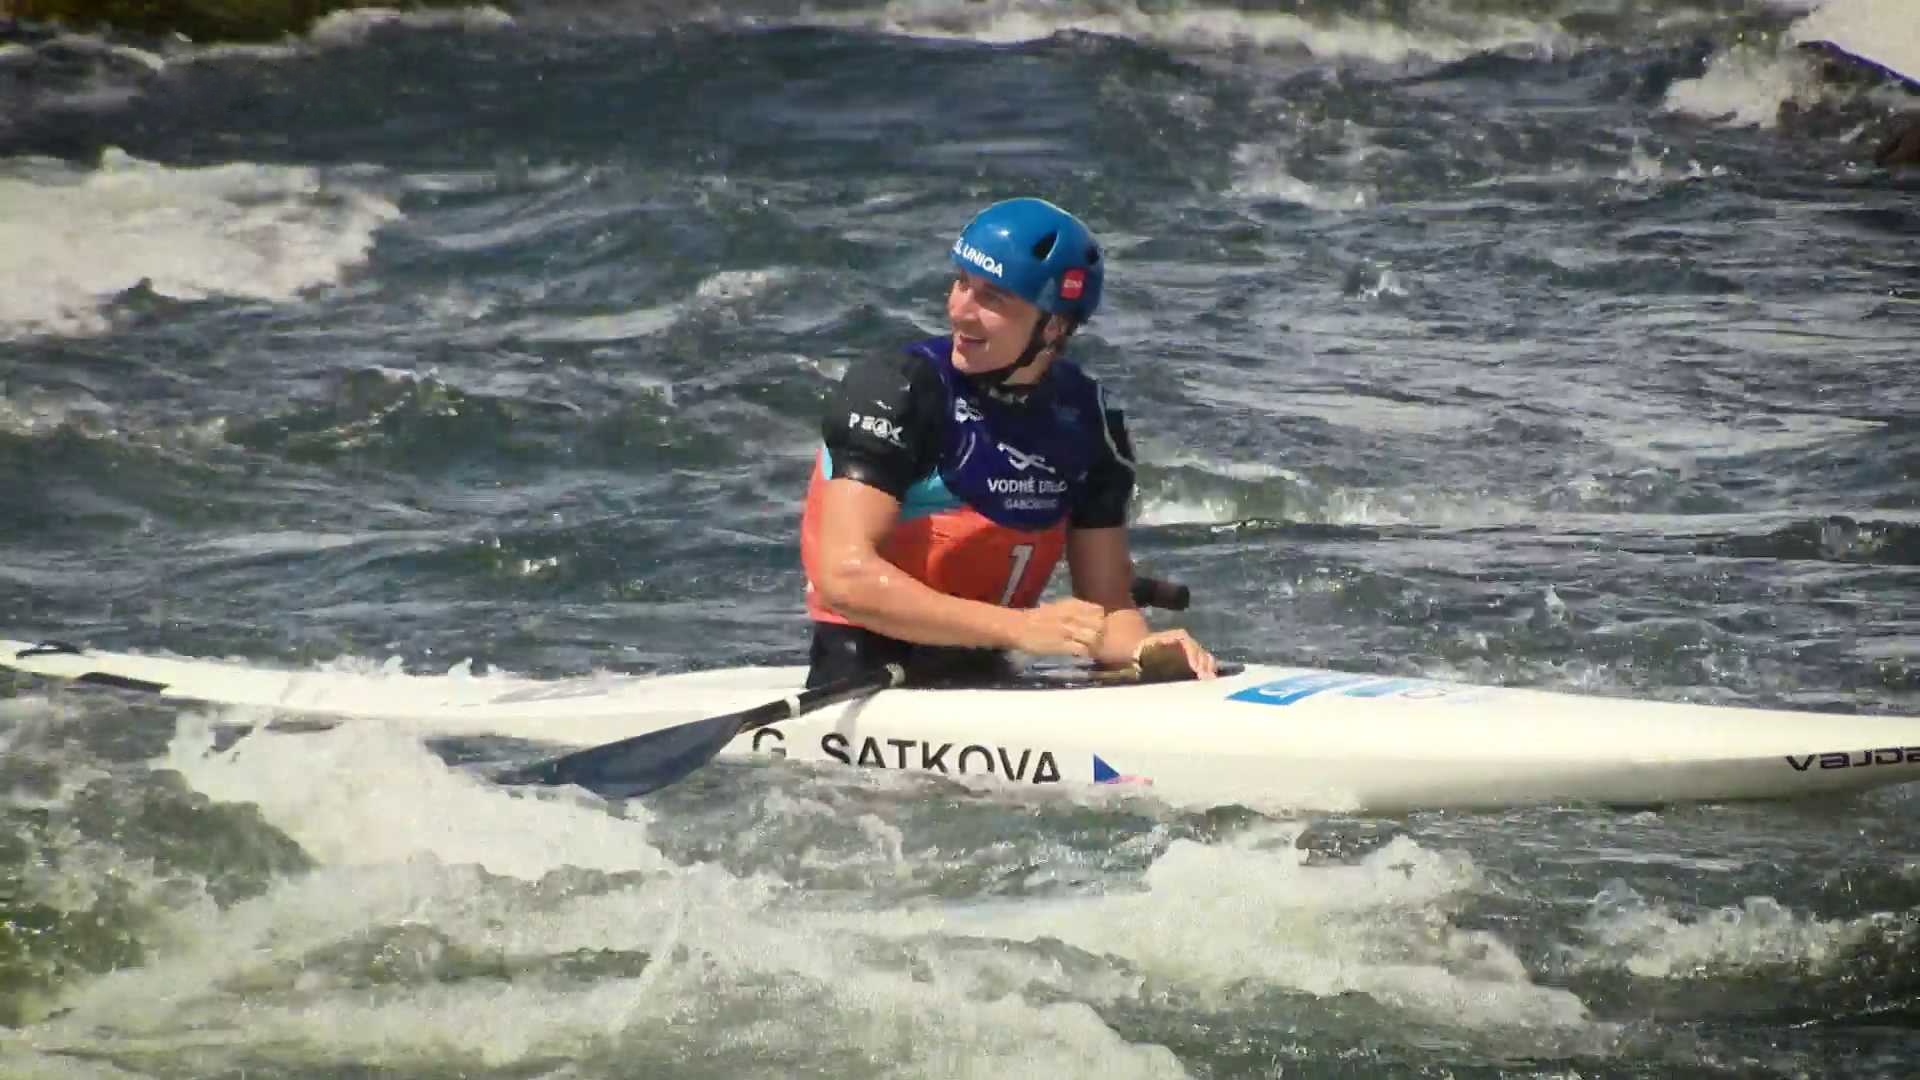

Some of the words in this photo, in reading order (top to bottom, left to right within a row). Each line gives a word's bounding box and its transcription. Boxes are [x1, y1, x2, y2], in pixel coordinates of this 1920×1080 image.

[962, 243, 1003, 278] UNIQA
[1001, 544, 1034, 604] 1
[821, 733, 1061, 784] SATKOVA
